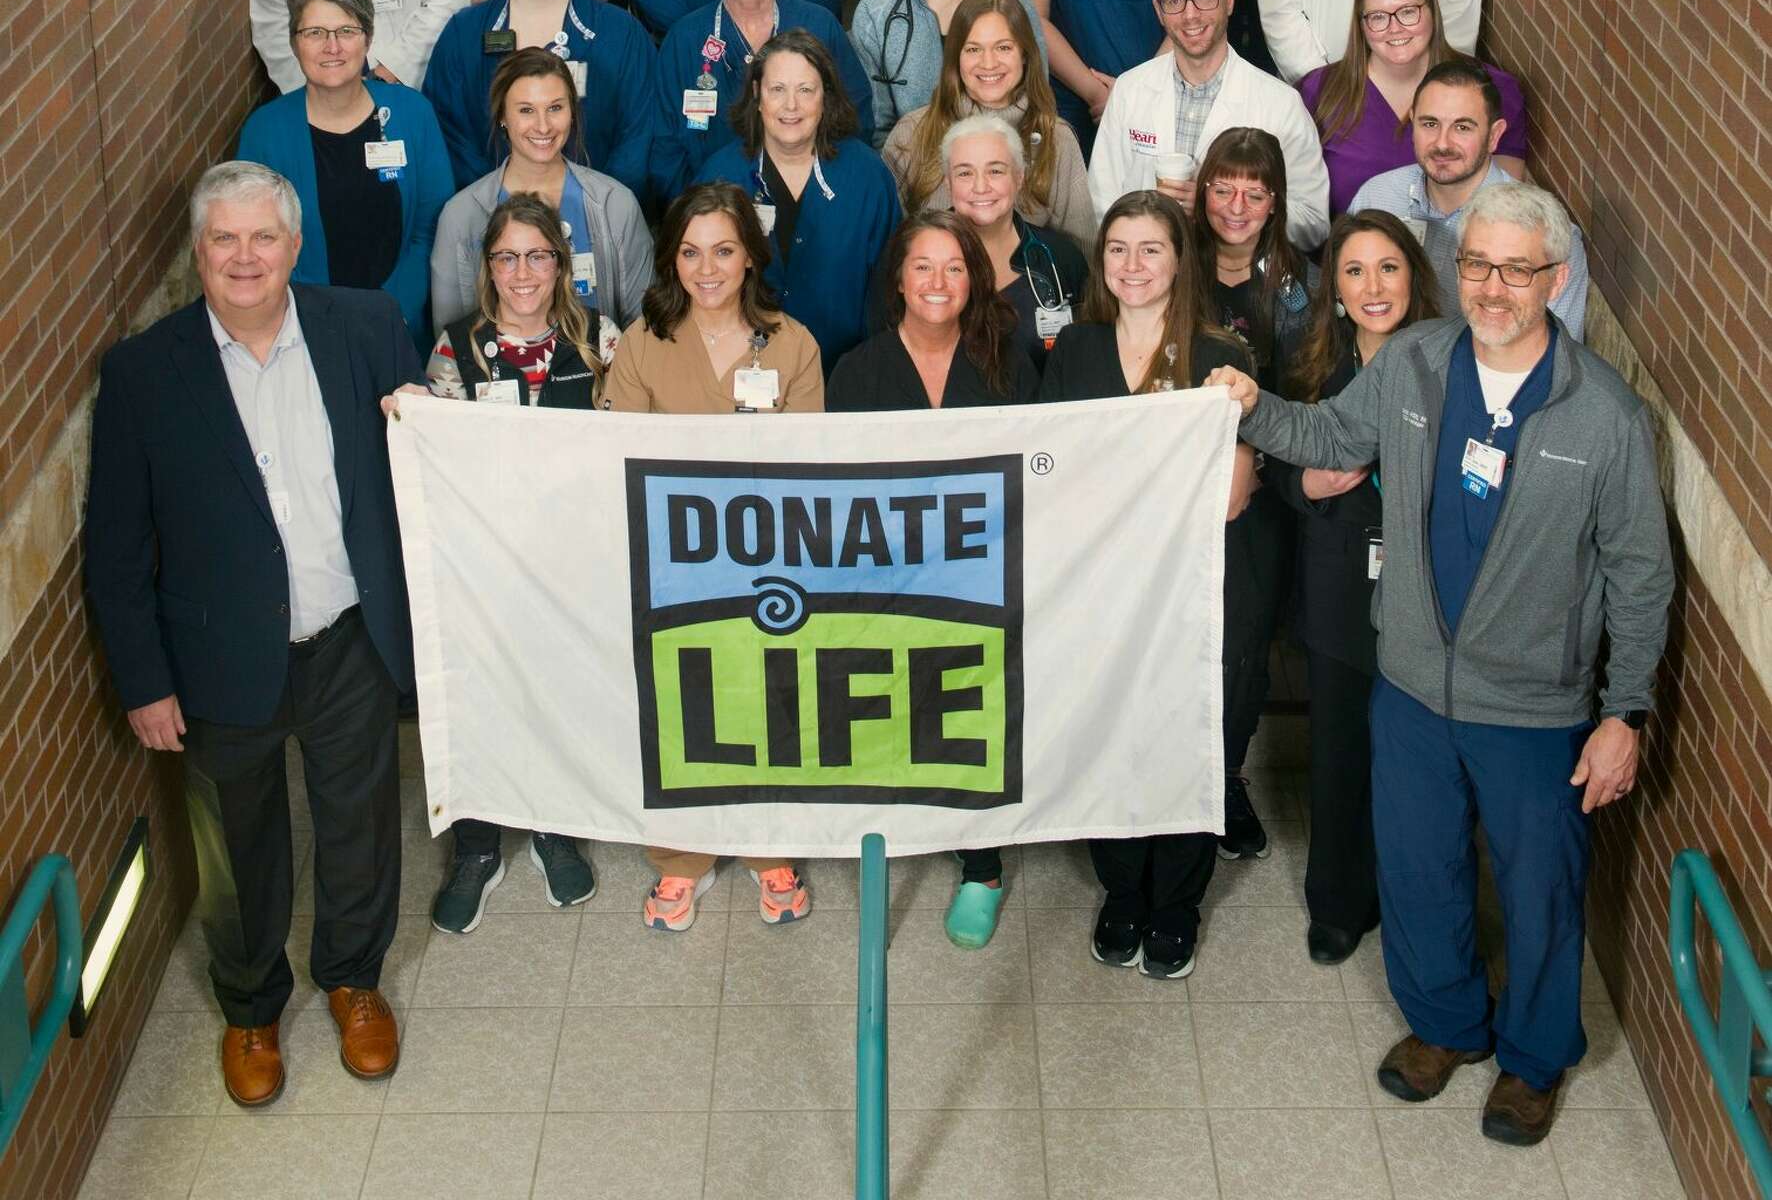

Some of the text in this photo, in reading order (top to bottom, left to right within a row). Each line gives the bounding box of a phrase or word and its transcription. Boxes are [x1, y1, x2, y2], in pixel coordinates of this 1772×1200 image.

[385, 170, 399, 180] RN
[1469, 481, 1481, 494] RN
[667, 492, 988, 568] DONATE
[678, 644, 987, 767] LIFE
